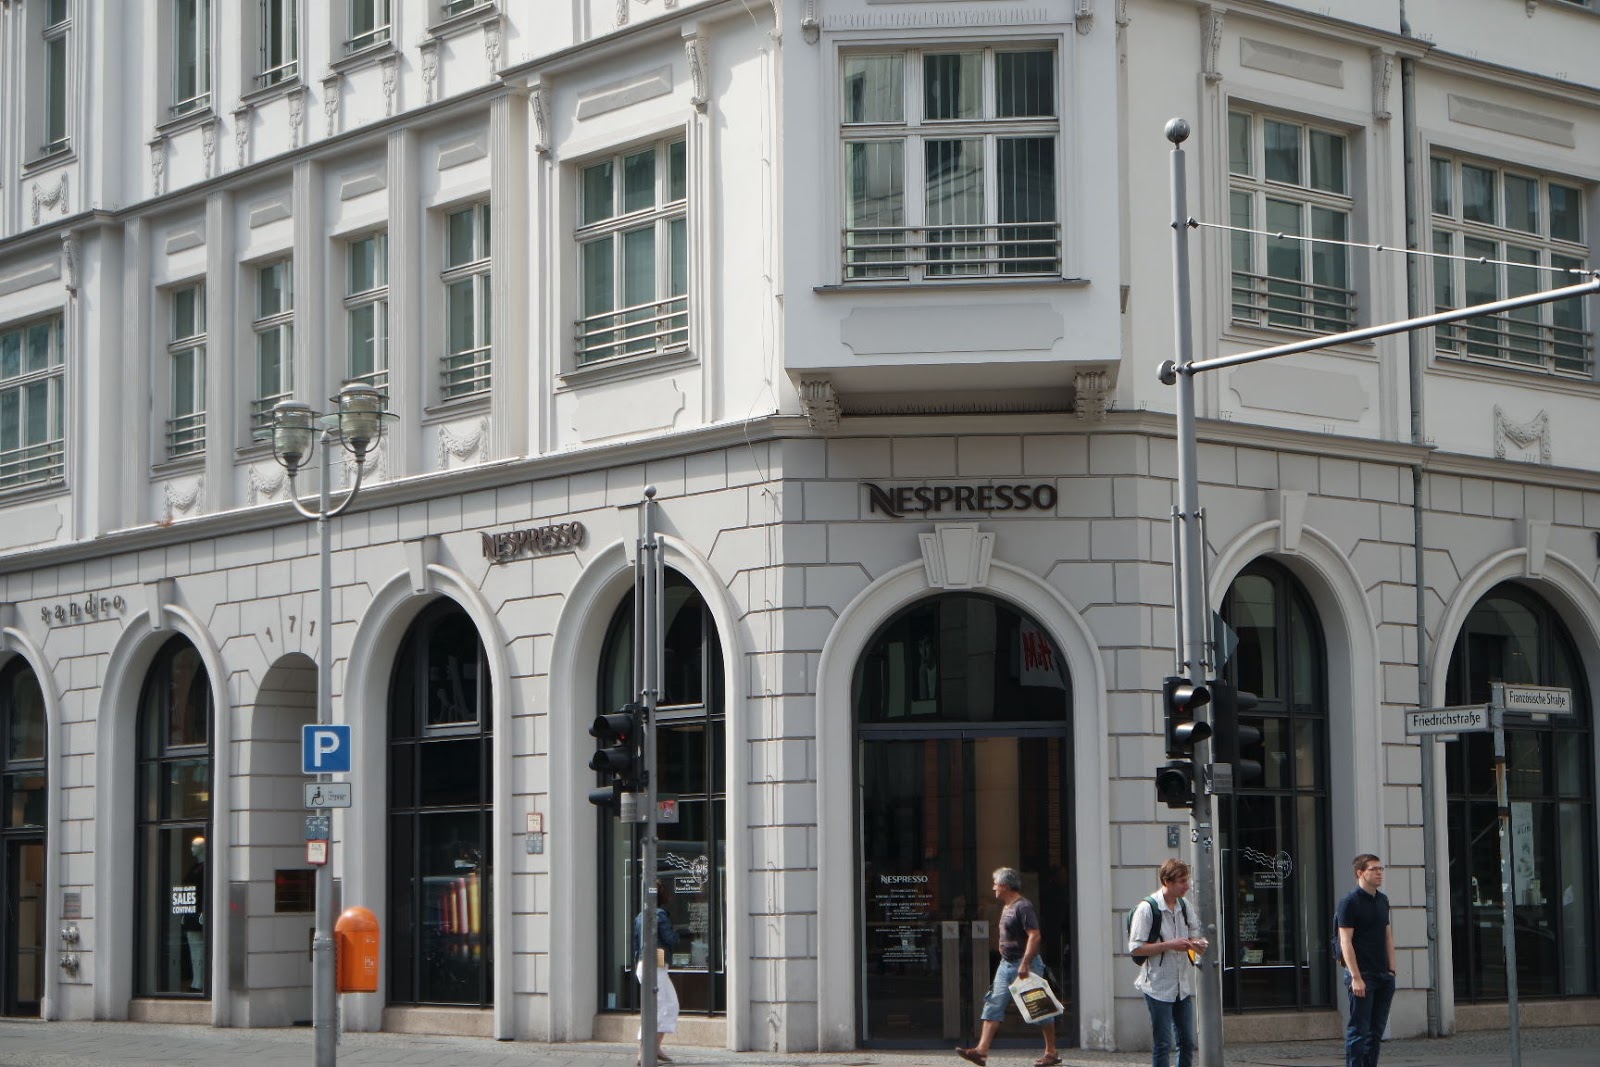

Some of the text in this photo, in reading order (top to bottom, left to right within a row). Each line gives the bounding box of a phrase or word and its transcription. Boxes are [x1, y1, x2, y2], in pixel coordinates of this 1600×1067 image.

[861, 482, 1057, 518] NESPRESSO
[478, 520, 586, 564] NESPRESSO
[41, 593, 124, 623] sandro
[1509, 690, 1566, 708] Französische Straße
[1413, 711, 1481, 727] Friedrichstraße
[314, 731, 340, 767] P
[880, 874, 929, 884] NESPRESSO
[172, 892, 196, 905] SALES
